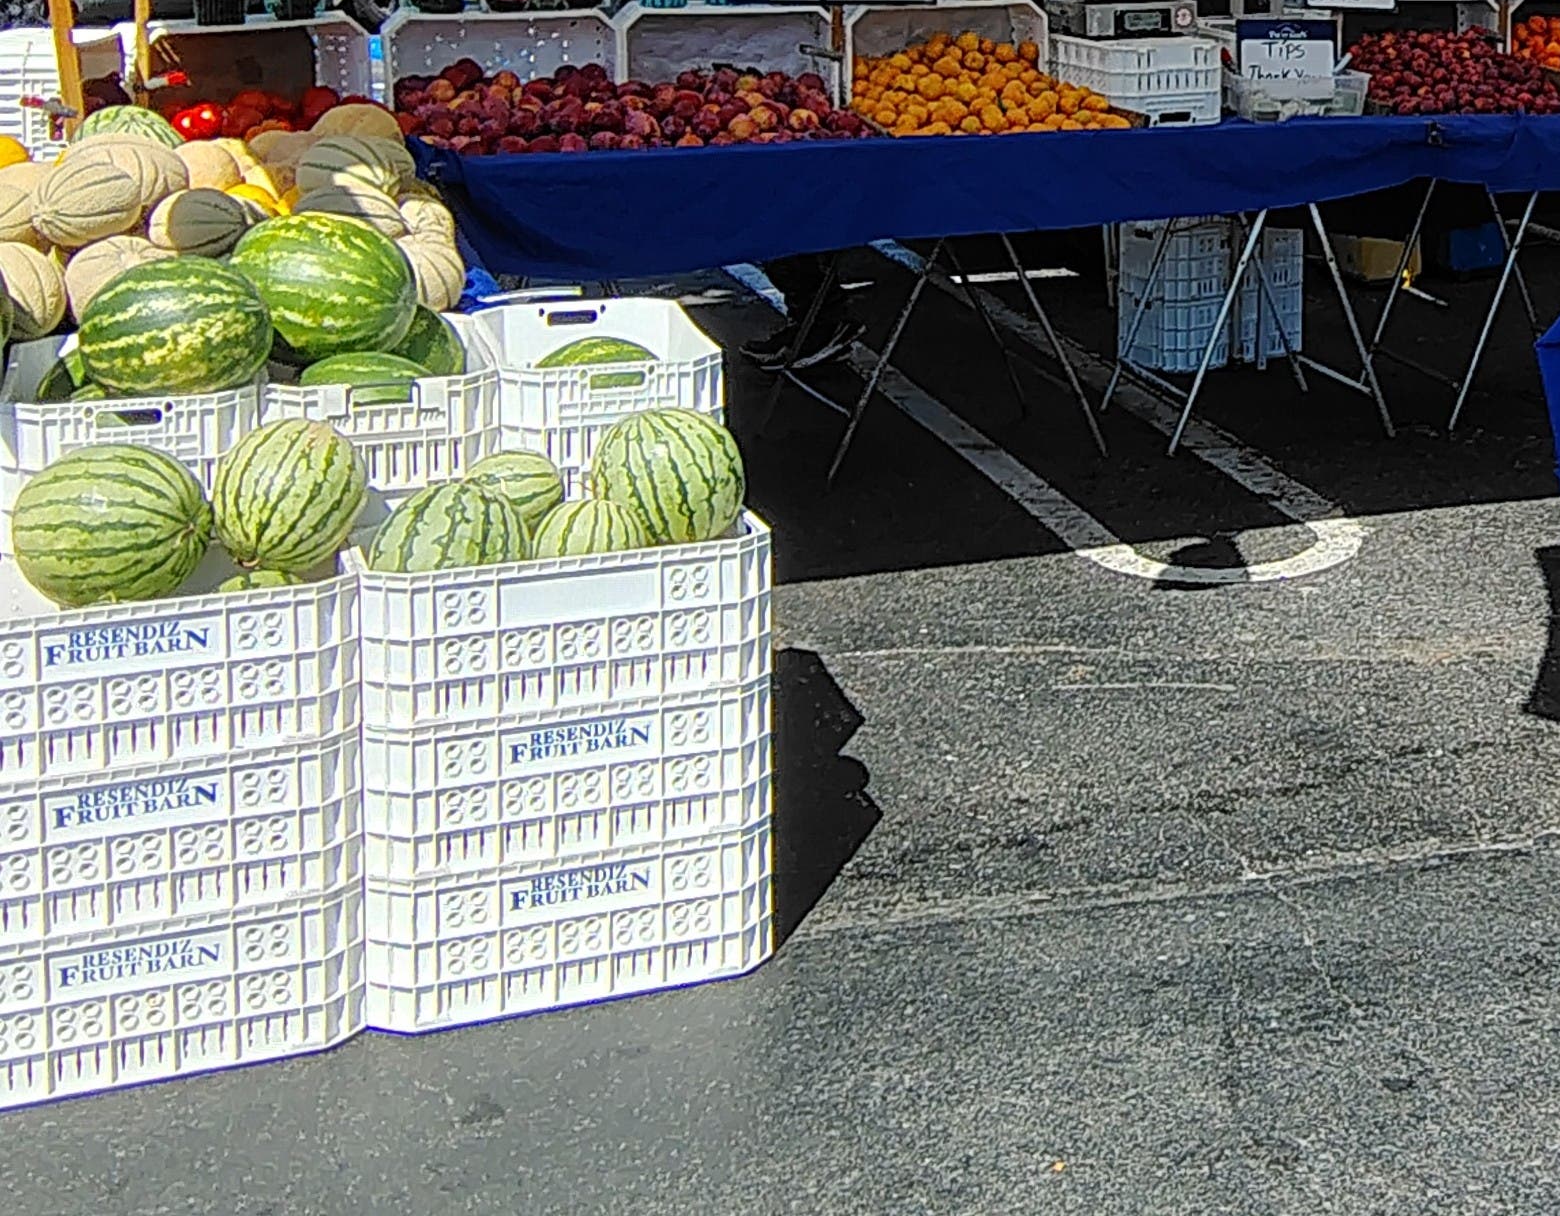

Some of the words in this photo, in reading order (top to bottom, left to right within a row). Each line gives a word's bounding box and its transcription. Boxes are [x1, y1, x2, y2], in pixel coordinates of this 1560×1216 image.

[44, 643, 128, 666] FRUIT
[135, 627, 210, 656] BARN
[68, 621, 180, 648] RESENDIZ
[509, 741, 582, 764] FRUIT
[586, 724, 650, 753] BARN
[530, 719, 626, 746] RESENDIZ
[53, 802, 138, 829] FRUIT
[144, 782, 219, 814] BARN
[77, 777, 189, 809] RESENDIZ
[510, 887, 582, 911] FRUIT
[587, 867, 650, 898] BARN
[531, 864, 627, 892] RESENDIZ
[59, 962, 142, 987] FRUIT
[147, 943, 220, 974] BARN
[82, 939, 193, 968] RESENDIZ
